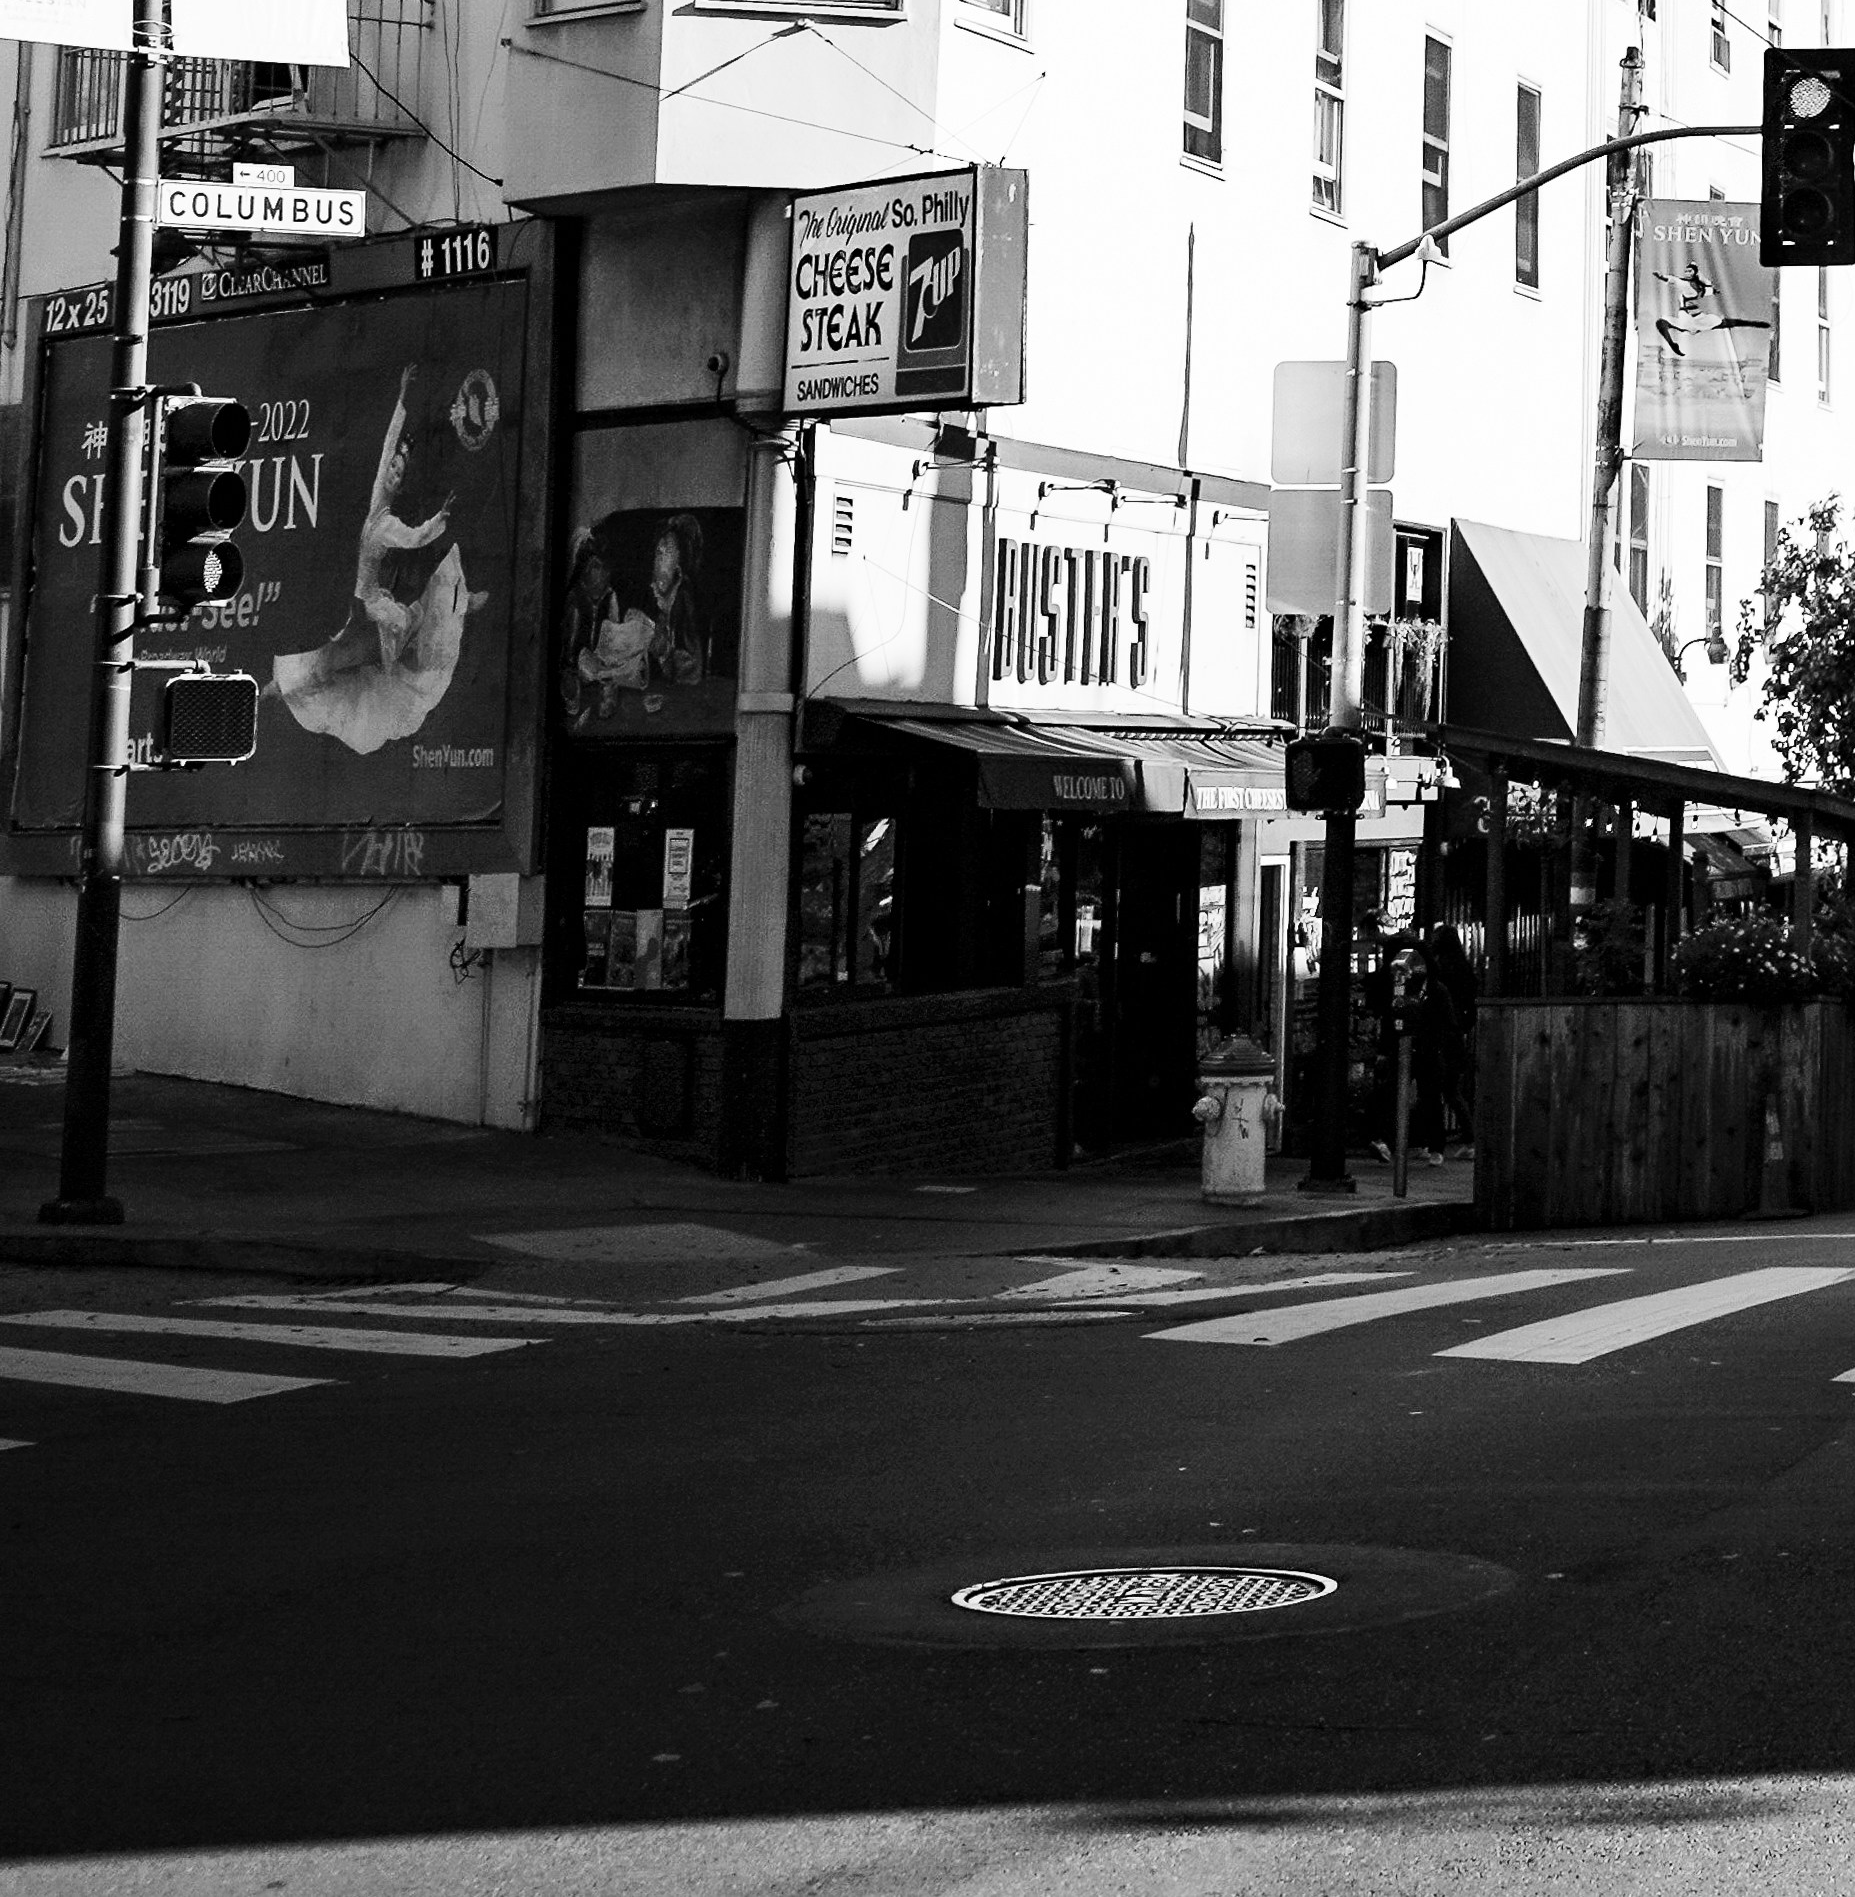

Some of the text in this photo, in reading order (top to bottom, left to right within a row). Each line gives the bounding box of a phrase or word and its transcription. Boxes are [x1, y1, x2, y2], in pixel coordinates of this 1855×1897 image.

[256, 168, 286, 183] 400
[169, 190, 355, 226] COLUMBUS
[800, 190, 970, 250] The Original So. Philly
[1653, 225, 1761, 246] SHEN YUN
[440, 230, 490, 276] 1116
[795, 243, 895, 301] CHEESE
[801, 301, 884, 352] STEAK
[797, 373, 879, 402] SANDWICHES
[250, 399, 310, 443] -2022
[992, 538, 1152, 689] BUSTER'S
[194, 644, 227, 663] World
[412, 744, 494, 769] ShenYun.com
[1053, 775, 1125, 800] WELCOME TO
[1196, 786, 1287, 810] THE FIRST CHEESES
